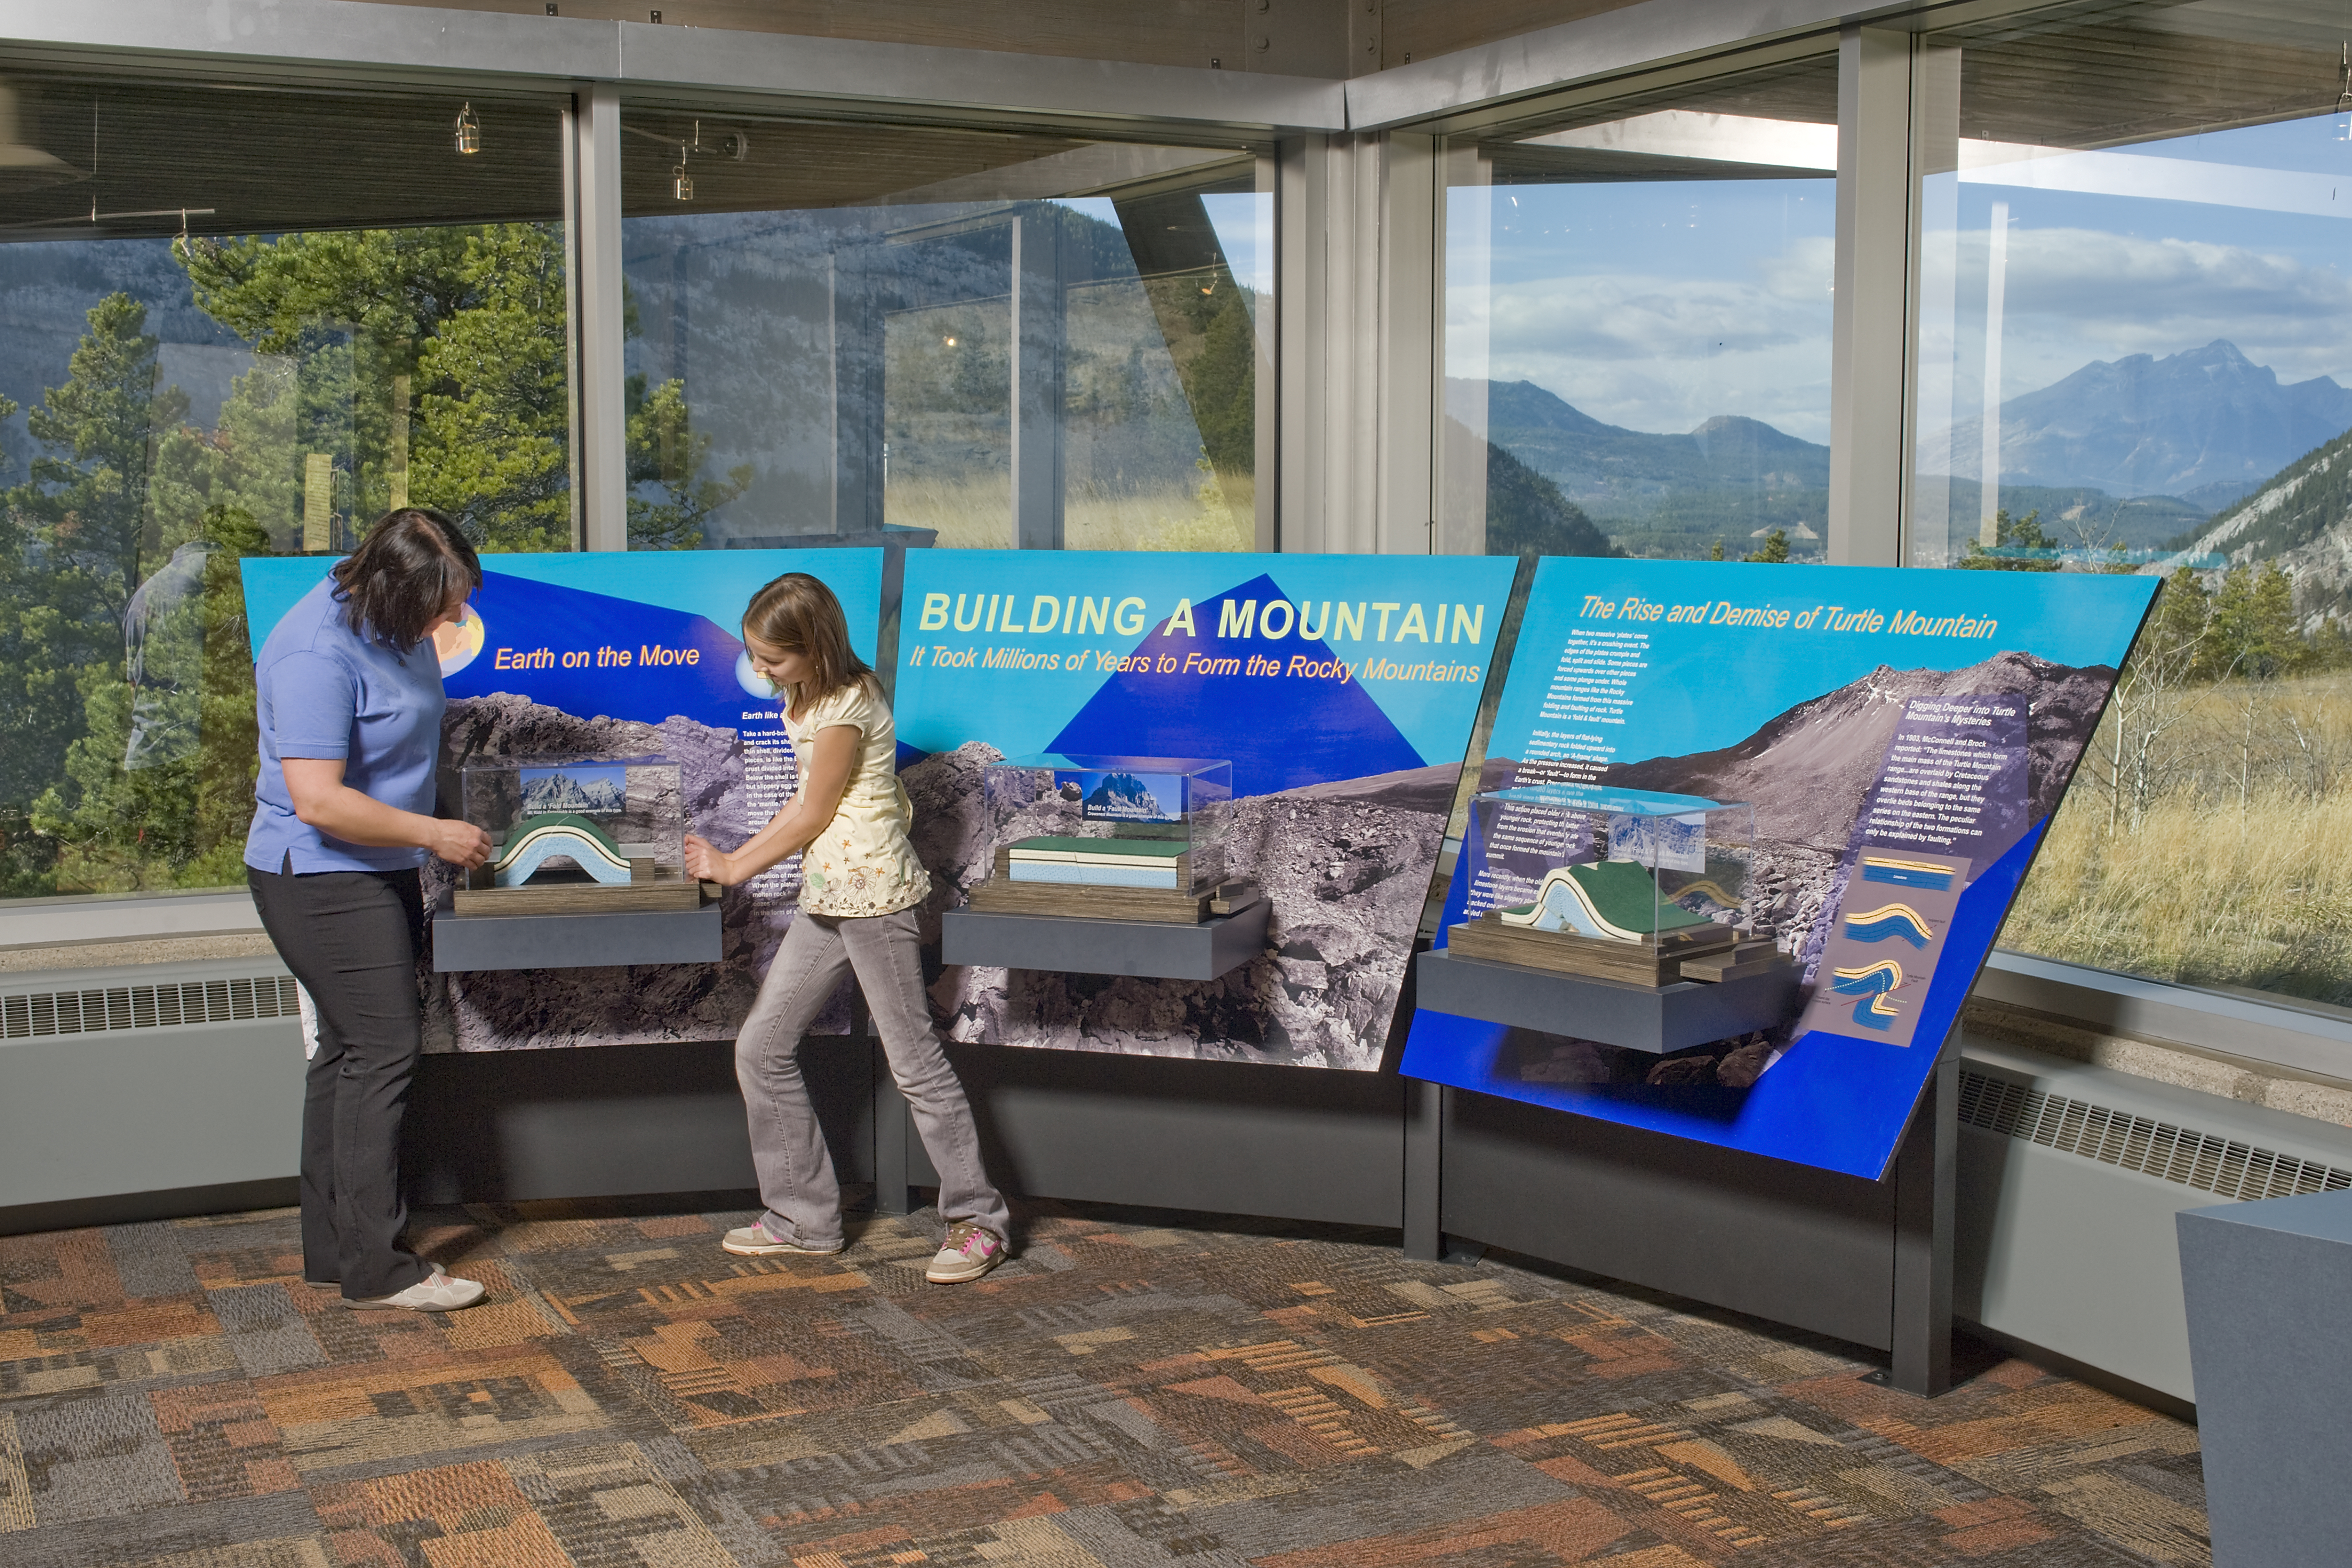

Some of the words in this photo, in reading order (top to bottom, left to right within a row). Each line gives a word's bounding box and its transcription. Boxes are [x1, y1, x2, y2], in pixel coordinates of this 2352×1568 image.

[919, 593, 1146, 636] BUILDING
[1163, 598, 1196, 637] A
[1218, 599, 1484, 644] MOUNTAIN
[1579, 595, 1615, 619] The
[1618, 597, 1664, 621] Rise
[1667, 601, 1711, 624] and
[1710, 602, 1790, 628] Demise
[1794, 606, 1824, 629] of
[1824, 606, 1884, 633] Turtle
[1887, 609, 1998, 639] Mountain
[494, 648, 555, 670] Earth
[562, 651, 590, 667] on
[597, 646, 632, 666] the
[639, 644, 700, 666] Move
[909, 645, 925, 666] It
[931, 646, 977, 667] Took
[982, 647, 1060, 670] Millions
[1065, 650, 1090, 671] of
[1096, 650, 1151, 672] Years
[1156, 653, 1177, 673] to
[1183, 652, 1240, 676] Form
[1245, 654, 1281, 677] the
[1286, 655, 1357, 684] Rocky
[1362, 658, 1481, 682] Mountains
[1909, 700, 1942, 713] Digging
[1942, 703, 1973, 714] Deeper
[1973, 705, 1990, 714] into
[1992, 707, 2015, 716] Turtle
[1905, 711, 1950, 723] Mountain's
[1951, 715, 1991, 725] Mysteries
[1922, 736, 1954, 744] McConnell
[1939, 748, 1971, 757] limestones
[1559, 762, 1584, 770] increased,
[1972, 762, 2001, 770] Mountain
[1954, 771, 1989, 780] Cretaceous
[1953, 782, 1970, 791] along
[1877, 796, 1897, 804] overlie
[1913, 800, 1944, 811] belonging
[1971, 795, 1985, 803] they
[1869, 817, 1905, 828] relationship
[1936, 824, 1969, 834] formations
[1918, 834, 1927, 842] by
